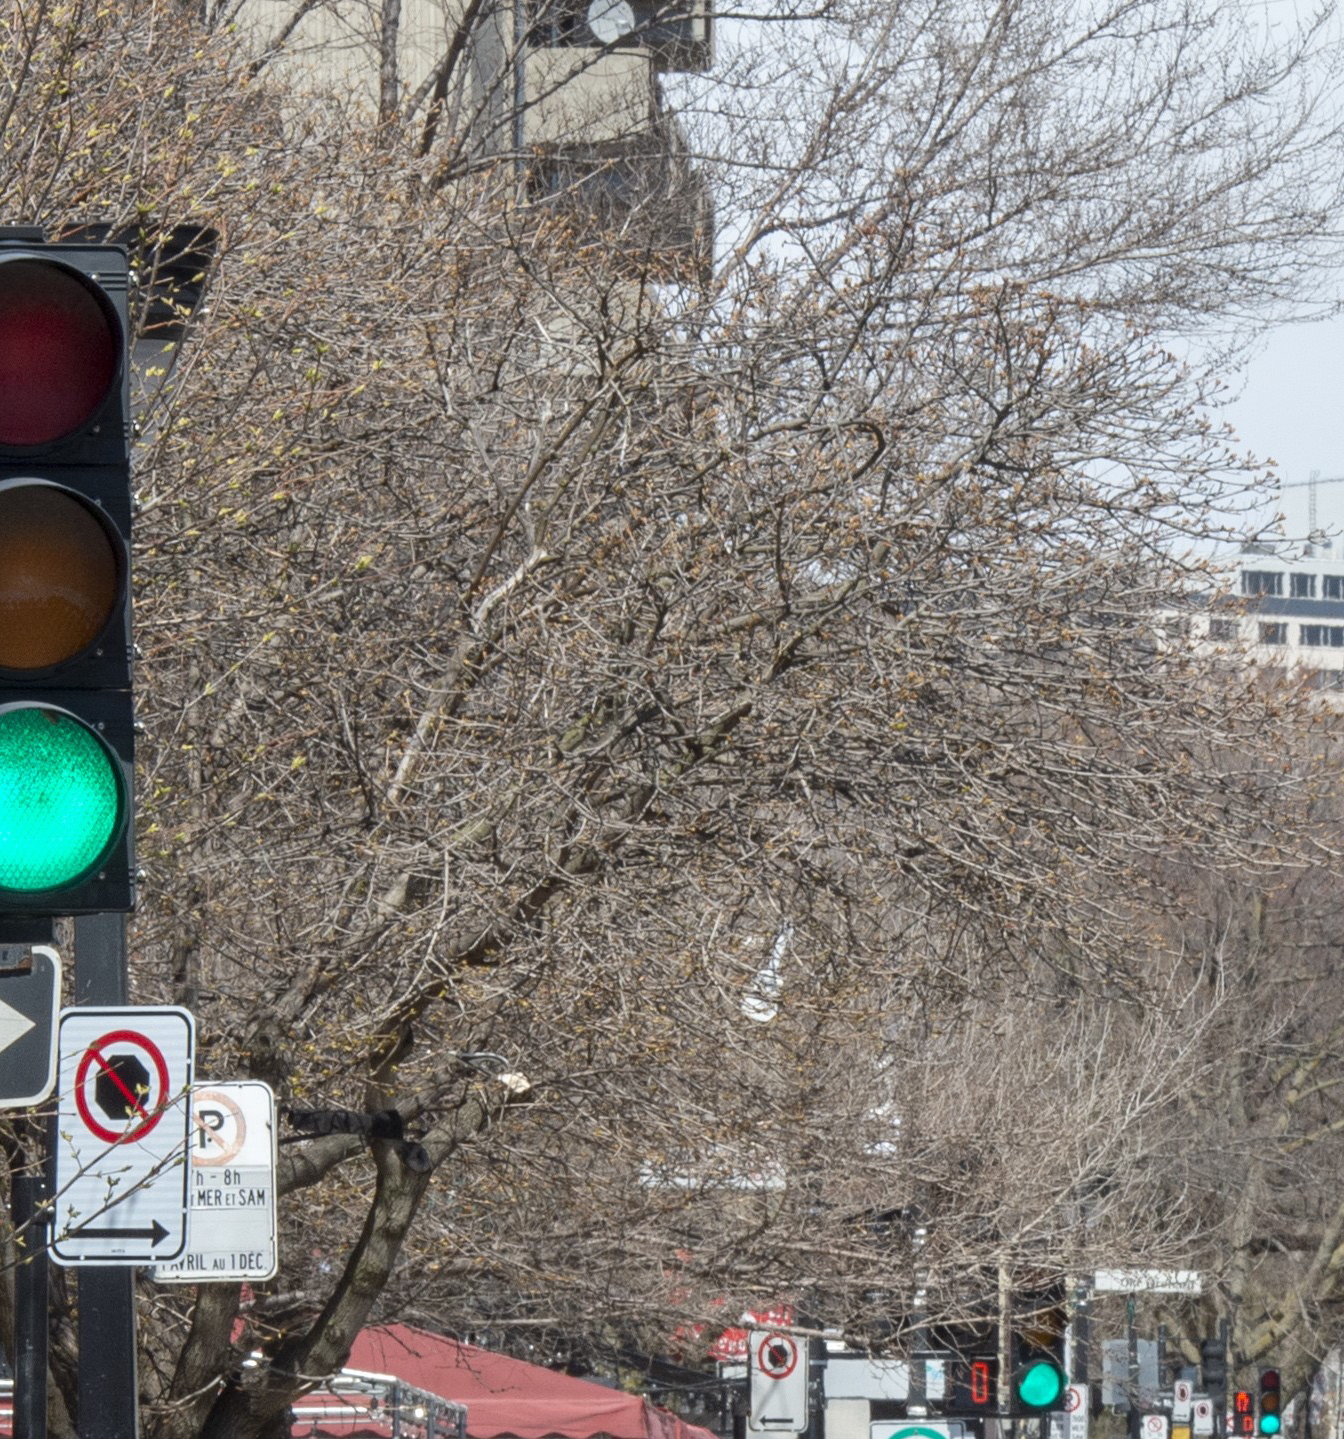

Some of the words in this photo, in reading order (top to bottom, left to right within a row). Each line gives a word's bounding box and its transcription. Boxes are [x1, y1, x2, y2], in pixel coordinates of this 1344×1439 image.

[223, 1168, 241, 1186] 8h
[197, 1189, 222, 1206] MER
[225, 1193, 236, 1206] ET
[238, 1189, 265, 1206] SAM
[212, 1258, 225, 1270] AU
